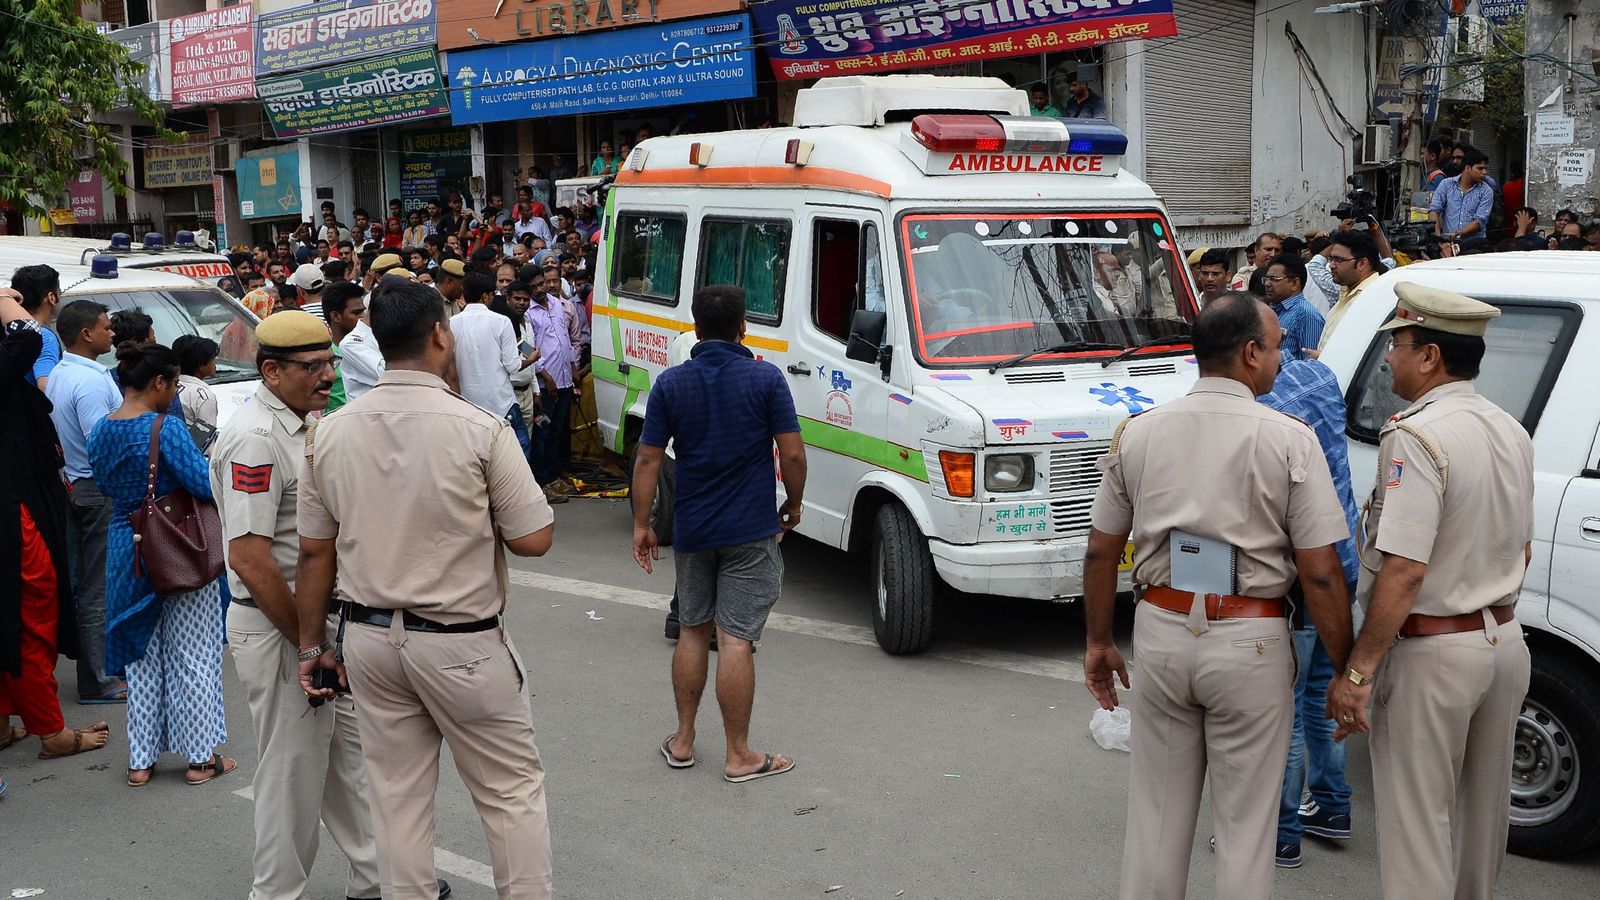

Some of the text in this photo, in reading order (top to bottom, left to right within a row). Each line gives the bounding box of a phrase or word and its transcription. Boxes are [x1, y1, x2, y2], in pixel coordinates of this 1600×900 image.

[219, 5, 250, 29] ACADEMY
[515, 0, 658, 35] LIBRARY
[795, 5, 817, 15] FULLY
[262, 18, 314, 51] सहारा
[185, 37, 237, 57] 11th & 12th
[174, 61, 186, 74] JEE
[481, 42, 743, 90] AAROGYA DIAGNOSTIC CENTRE
[481, 94, 500, 104] FULLY
[502, 88, 557, 102] COMPUTERISED
[558, 86, 577, 96] PATH
[621, 78, 651, 90] DIGITAL
[653, 75, 675, 86] X-RAY
[678, 74, 684, 83] &
[685, 71, 712, 82] ULTRA
[714, 68, 744, 80] SOUND
[265, 91, 316, 112] सहारा
[582, 98, 596, 106] Sant
[948, 154, 1103, 172] AMBULANCE
[999, 426, 1027, 441] शुभ
[996, 510, 1010, 521] हम
[1014, 505, 1025, 518] भी
[1010, 523, 1032, 535] खुदा
[1036, 520, 1047, 531] से
